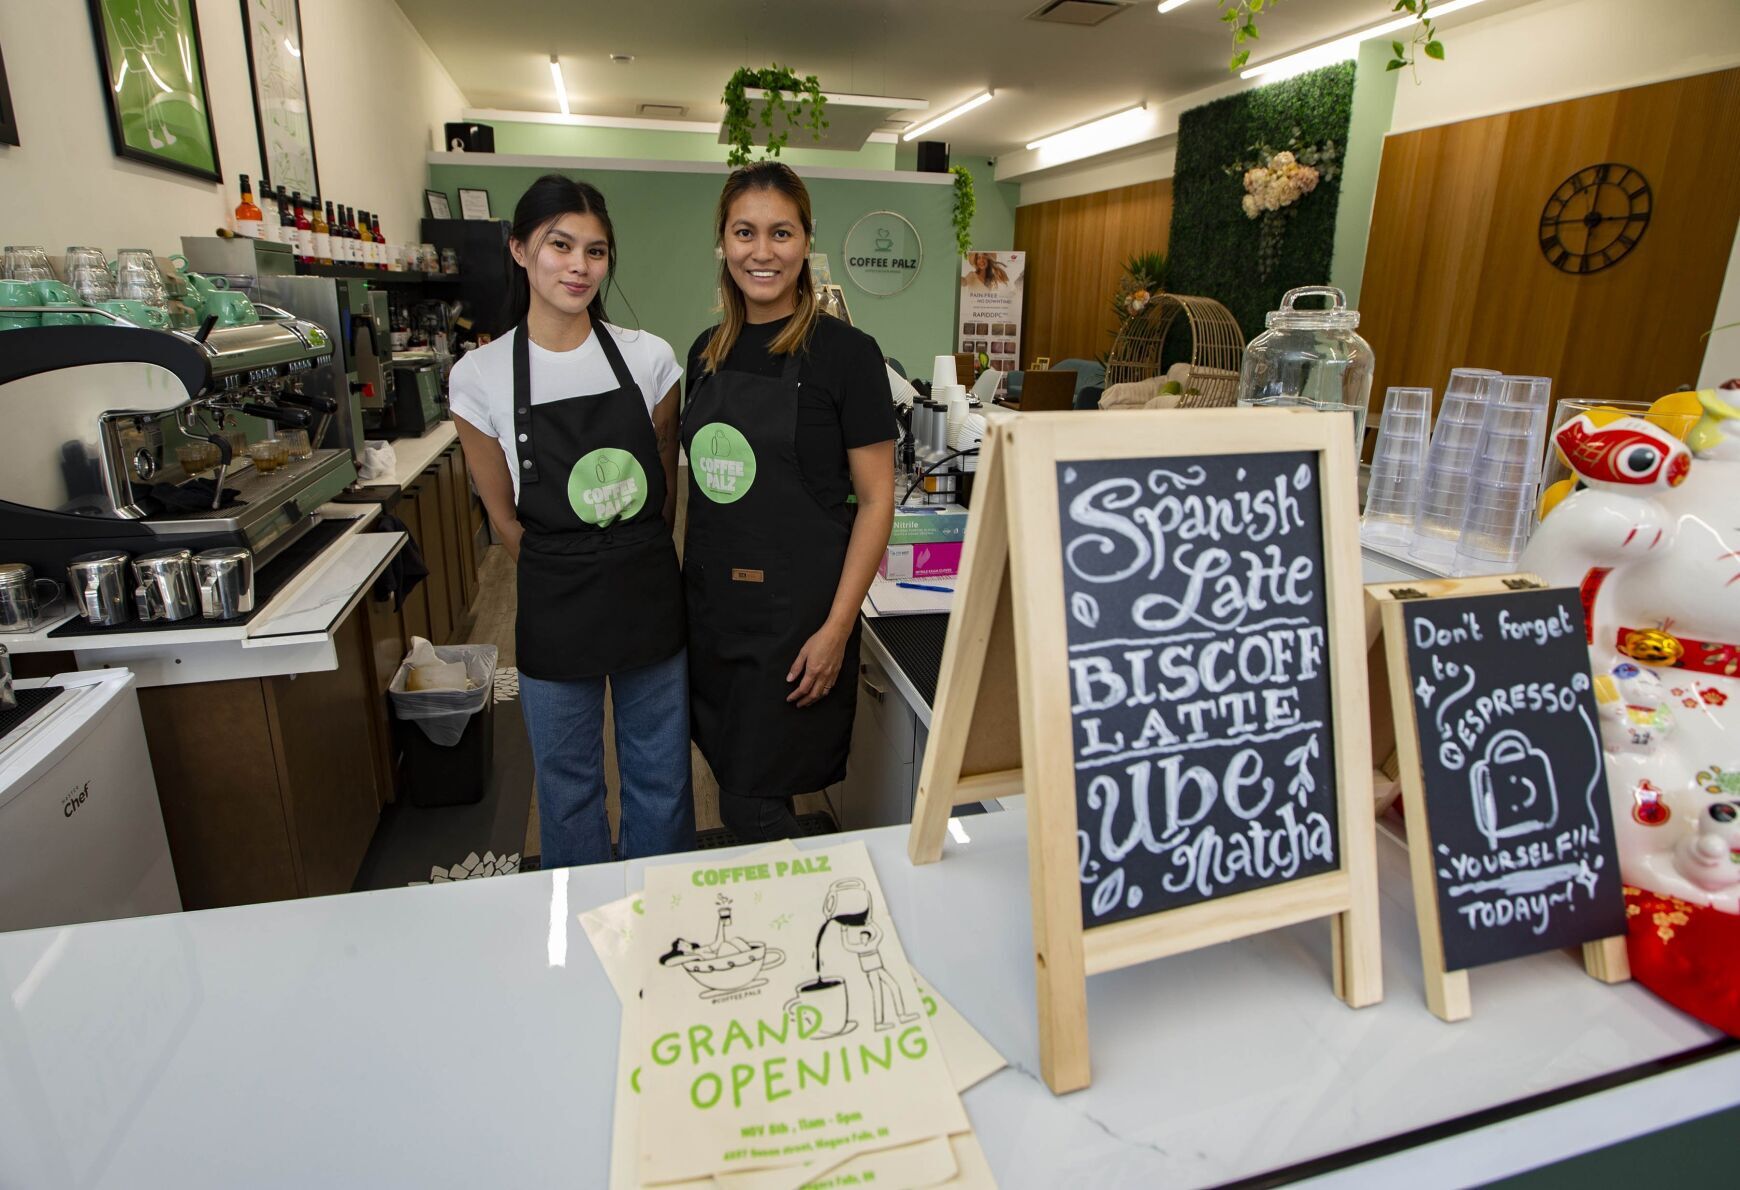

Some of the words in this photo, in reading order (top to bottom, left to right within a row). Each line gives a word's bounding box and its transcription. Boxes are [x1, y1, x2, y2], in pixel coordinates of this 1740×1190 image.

[849, 256, 888, 268] COFFEE
[891, 258, 917, 269] PALZ
[700, 457, 745, 477] COFFEE
[706, 474, 736, 492] PALZ
[583, 477, 638, 505] COFFEE
[1066, 467, 1304, 584] Spanish
[1131, 544, 1313, 632] Latte
[1413, 611, 1483, 650] Don't
[1498, 604, 1574, 646] forget
[1069, 626, 1325, 714] BISCOFF
[1432, 654, 1460, 681] to
[1080, 686, 1301, 757] LATTE
[1457, 681, 1577, 752] ESPRESSO
[64, 783, 89, 818] Chef
[1087, 748, 1275, 863] Ube
[691, 862, 771, 888] COFFEE
[775, 855, 832, 878] PALZ
[650, 1004, 823, 1067] GRAND
[689, 1026, 929, 1110] OPENING
[740, 1124, 764, 1137] NOV
